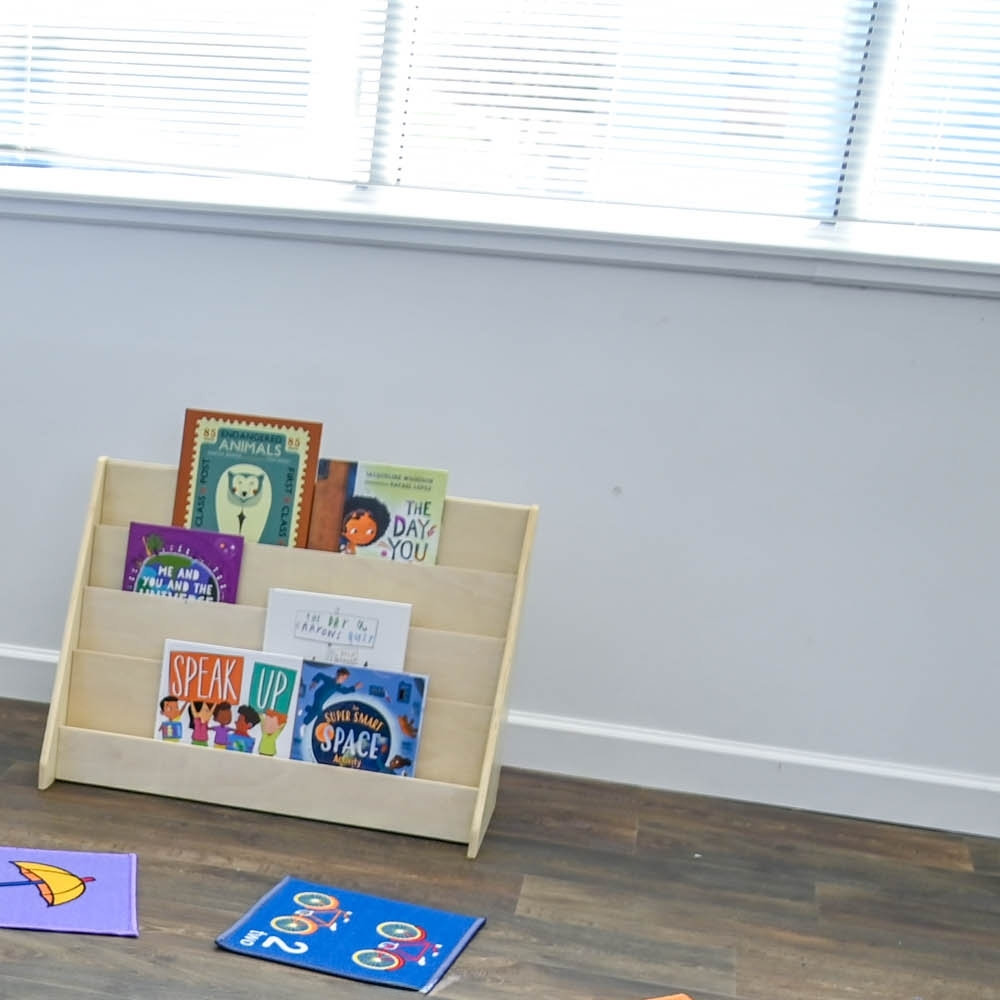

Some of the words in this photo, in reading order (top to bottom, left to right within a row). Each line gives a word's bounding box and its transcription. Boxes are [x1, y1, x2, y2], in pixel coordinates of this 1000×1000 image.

[220, 430, 282, 444] ENDANGERED
[287, 437, 301, 448] 85
[218, 440, 282, 456] ANIMALS
[200, 459, 210, 483] POST
[285, 467, 295, 494] FIRST
[407, 500, 432, 516] THE
[279, 505, 290, 537] CLASS
[393, 515, 430, 540] DAY
[387, 538, 429, 562] YOU
[158, 566, 174, 577] ME
[178, 568, 200, 580] AND
[142, 575, 163, 589] YOU
[167, 579, 189, 592] AND
[194, 582, 214, 595] THE
[172, 654, 238, 701] SPEAK
[257, 666, 288, 710] UP
[324, 709, 351, 723] SUPER
[354, 711, 385, 732] SMART
[320, 724, 382, 759] SPACE
[240, 929, 268, 946] two
[261, 935, 309, 954] 2
